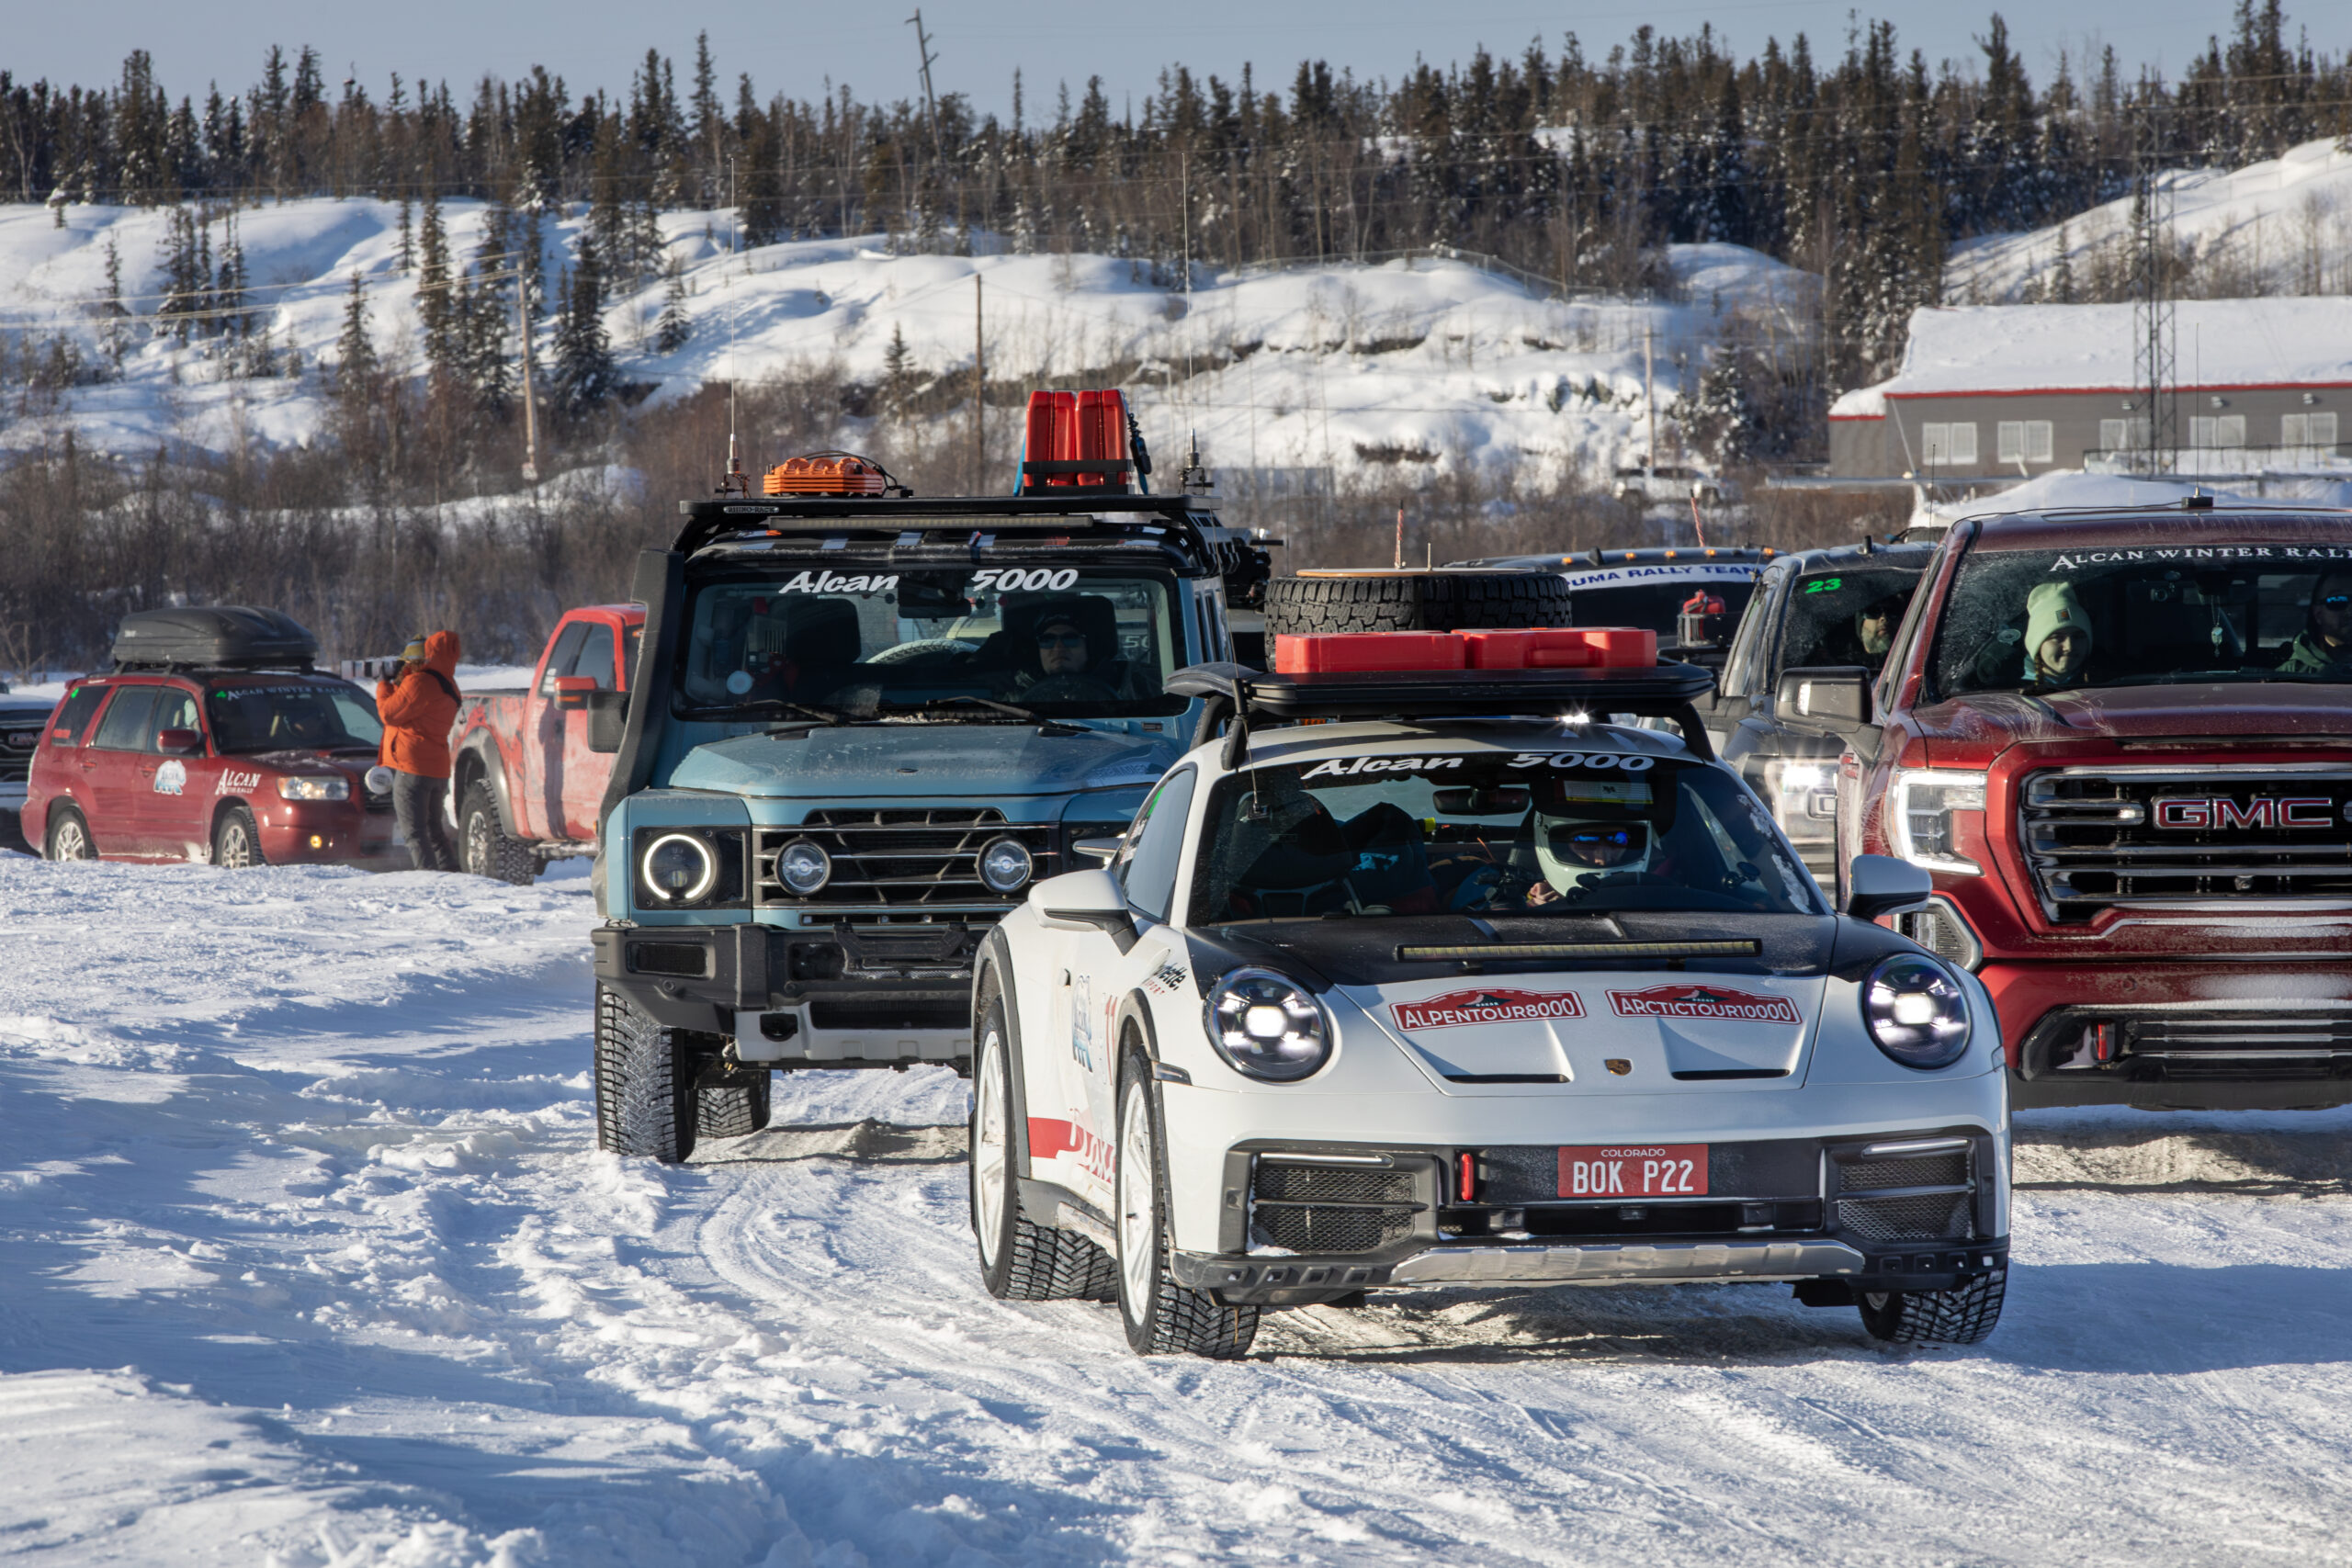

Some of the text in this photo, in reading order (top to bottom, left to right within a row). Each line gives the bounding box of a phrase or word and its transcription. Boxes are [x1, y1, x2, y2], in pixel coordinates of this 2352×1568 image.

[2049, 549, 2145, 572] ALCAN
[2155, 547, 2274, 558] WINTER
[778, 568, 1080, 594] Alcan 5000
[1566, 565, 1762, 587] UMA RALLY TEAM
[1804, 577, 1842, 594] 23
[1300, 752, 1655, 781] Alcan 5000
[215, 767, 262, 796] ALCAN
[2154, 796, 2334, 830] GMC
[1405, 998, 1577, 1028] ALPENTOUR8000
[1621, 997, 1792, 1021] ARCTICTOUR10000
[1600, 1147, 1667, 1158] COLORADO
[1572, 1159, 1694, 1194] BOK P22
